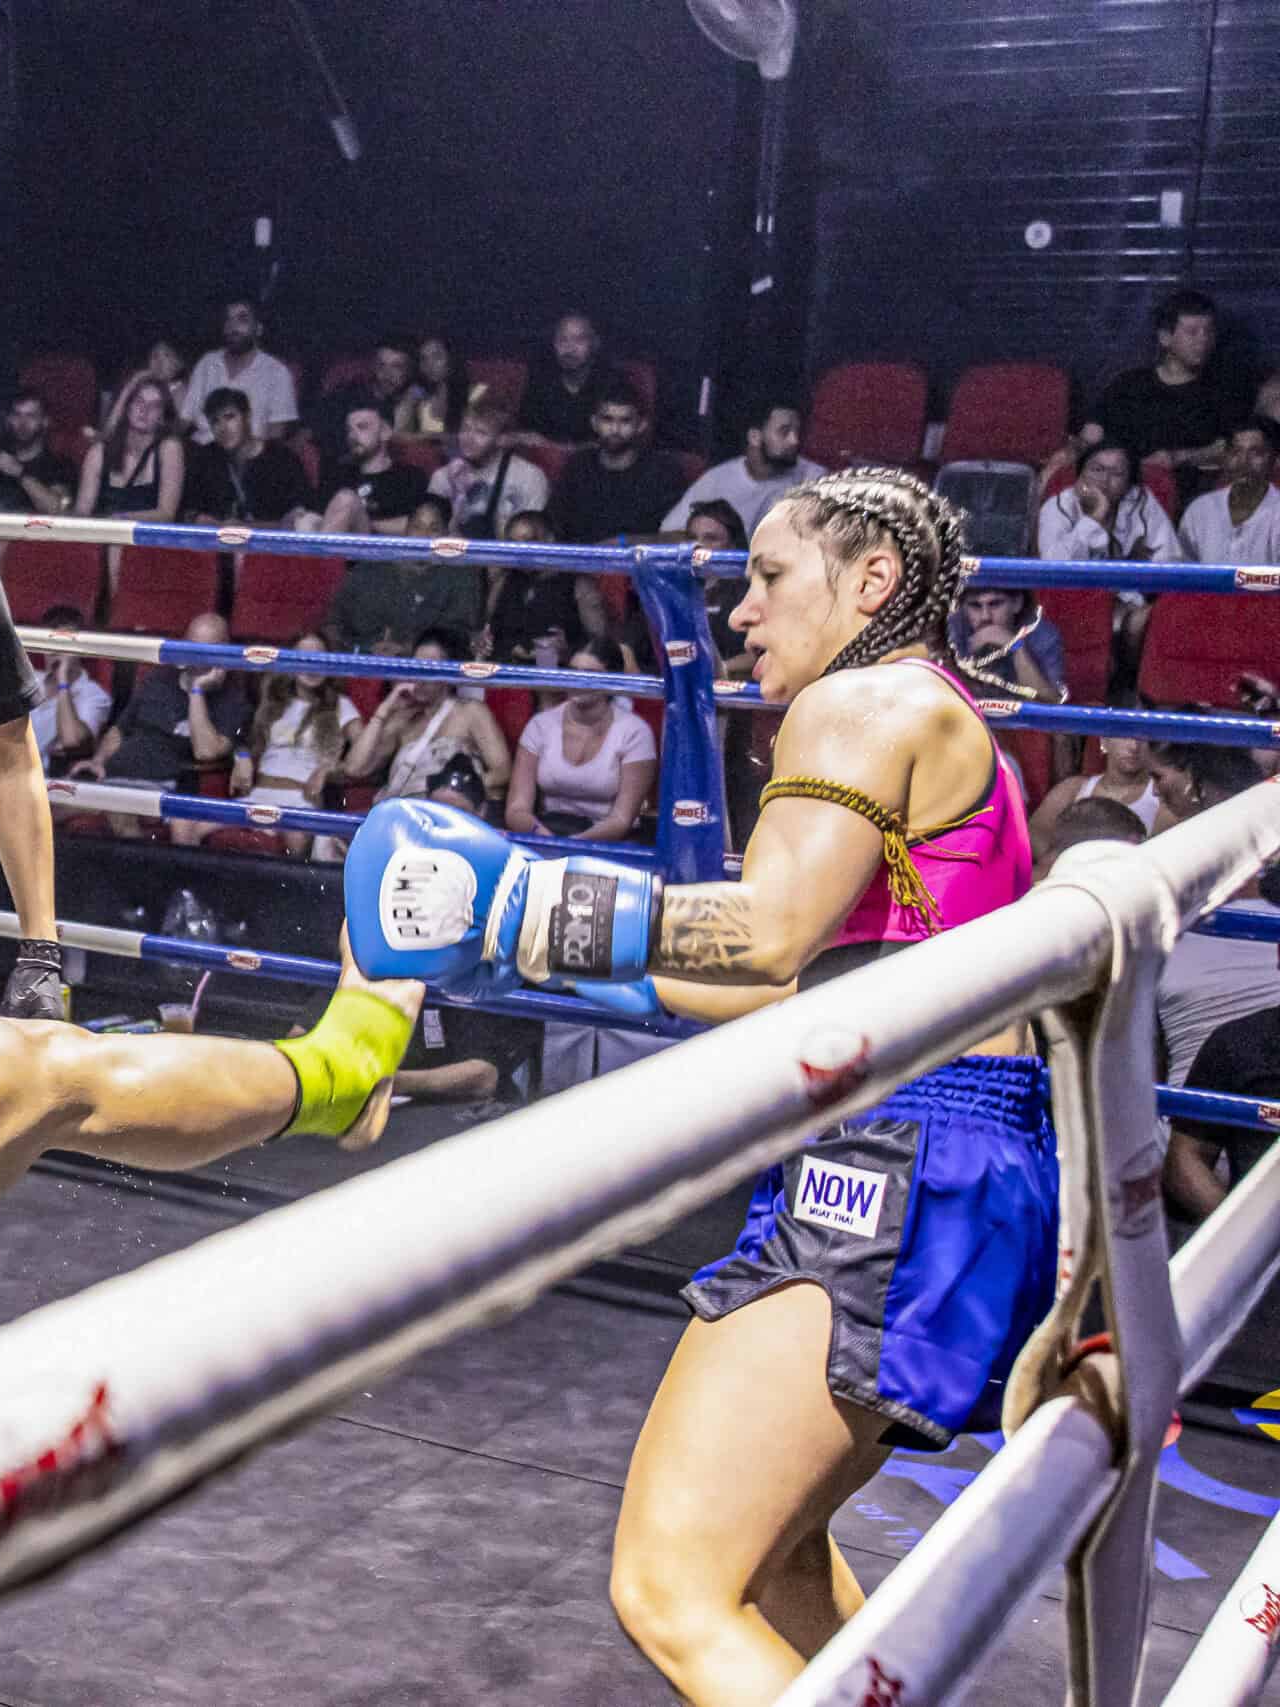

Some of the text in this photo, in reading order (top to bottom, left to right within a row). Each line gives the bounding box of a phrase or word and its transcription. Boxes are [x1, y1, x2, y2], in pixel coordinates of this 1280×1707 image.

[1236, 571, 1280, 587] SANDE
[801, 1167, 877, 1218] NOW
[809, 1206, 854, 1225] MUAY THAI
